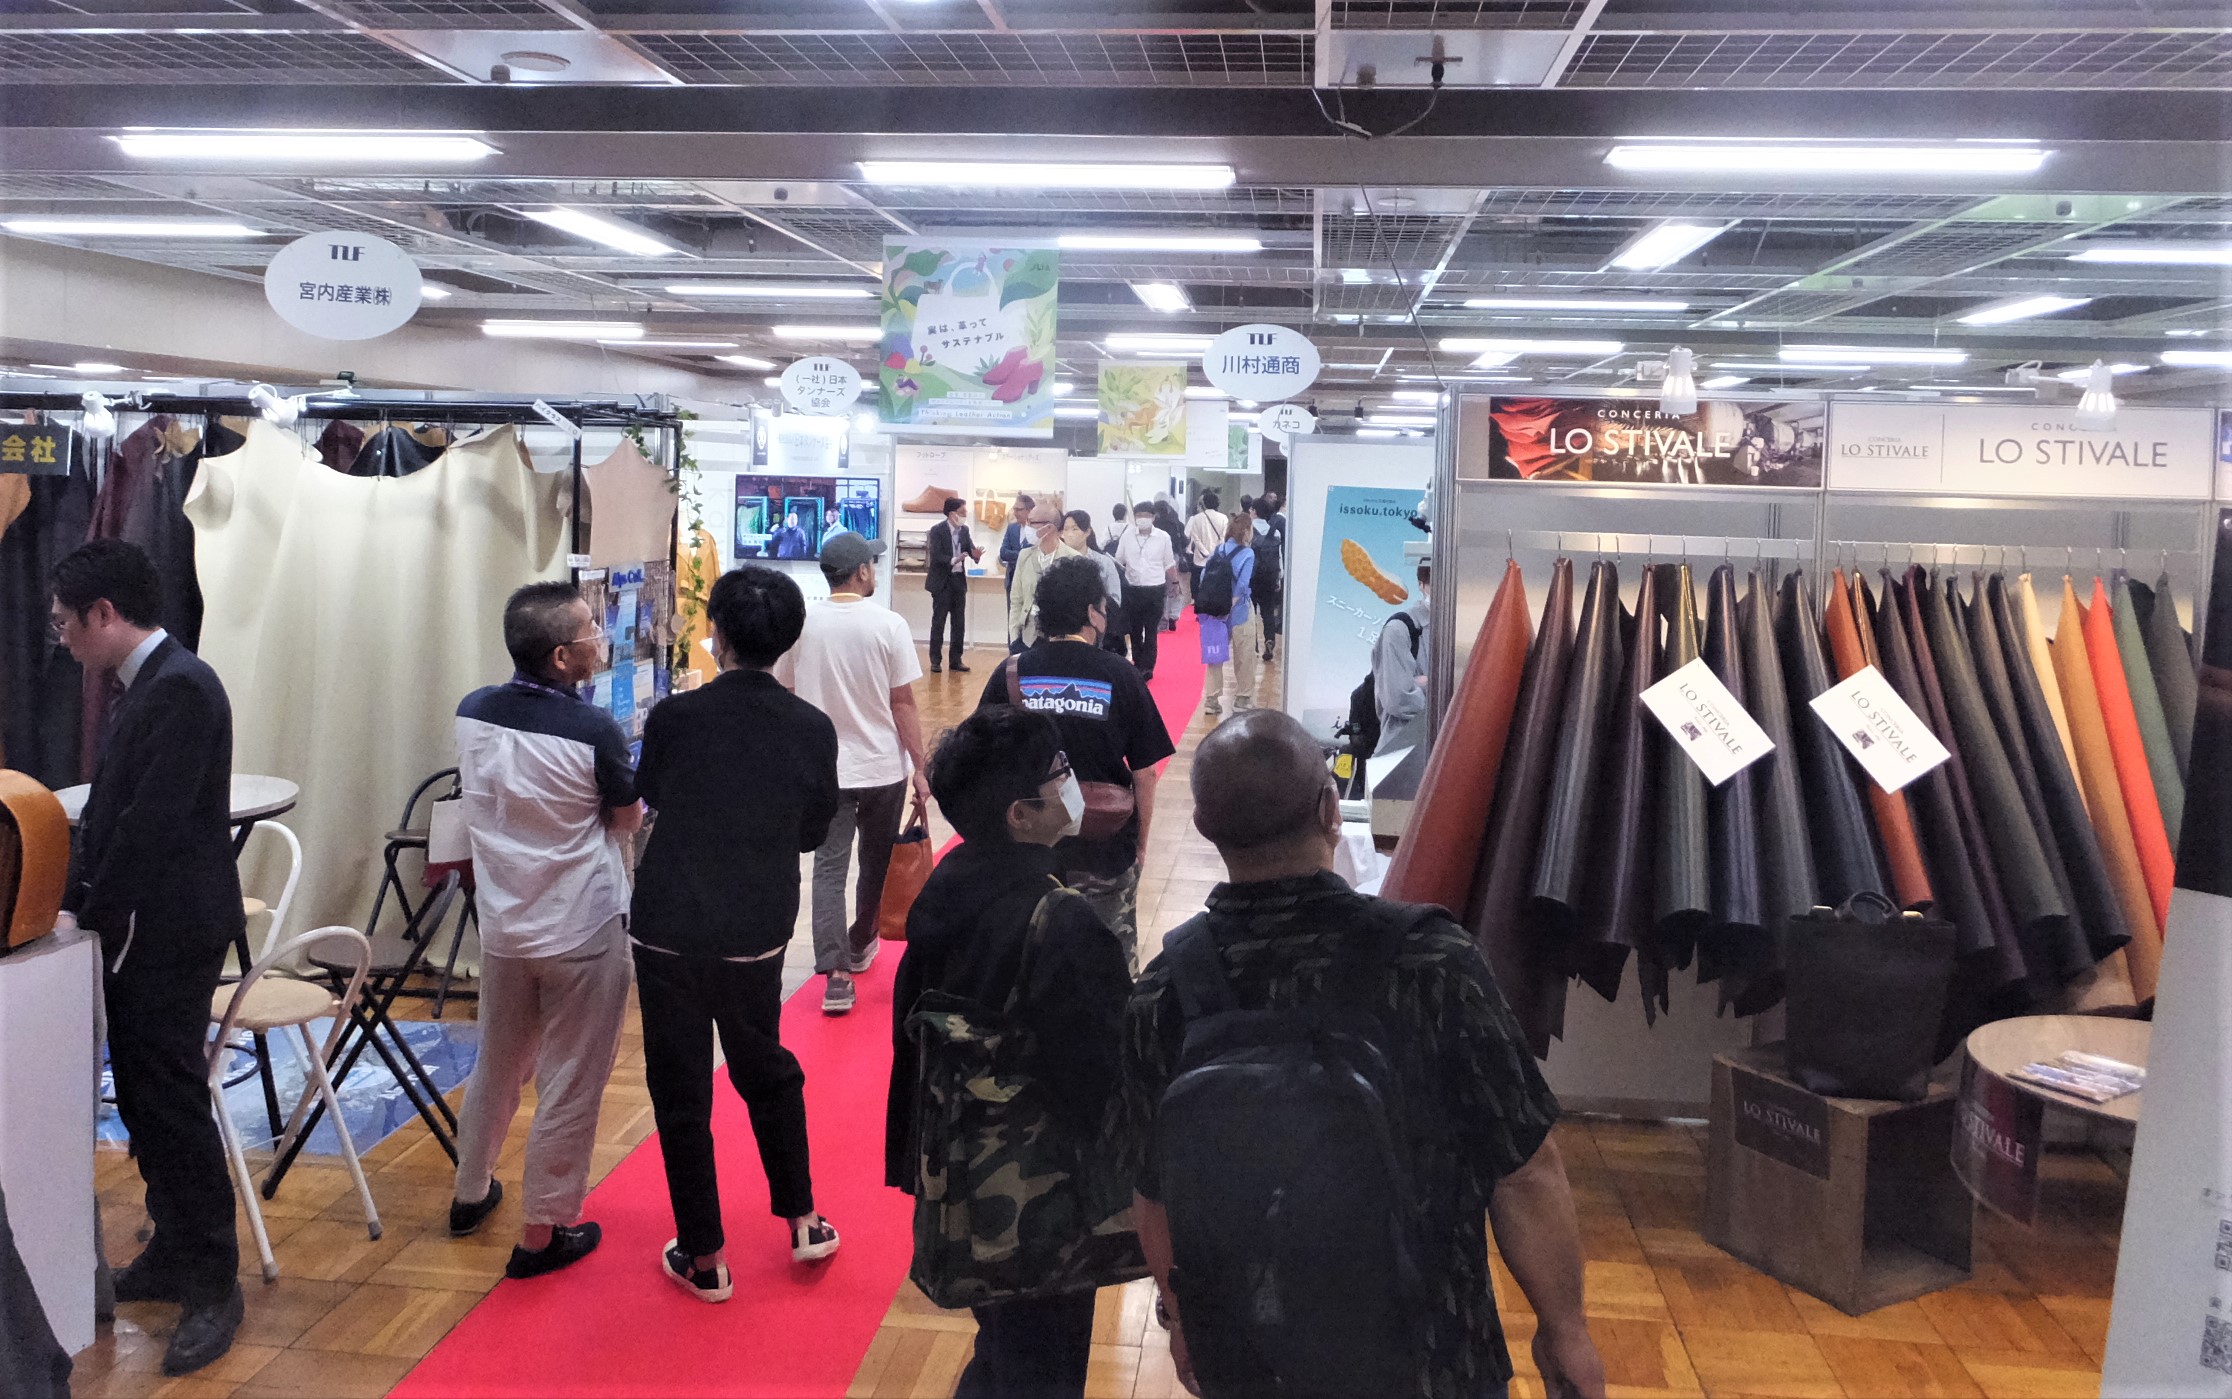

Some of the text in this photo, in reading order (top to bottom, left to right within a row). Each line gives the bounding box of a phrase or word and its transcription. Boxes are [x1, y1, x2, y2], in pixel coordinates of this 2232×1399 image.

[941, 332, 1005, 349] サステナブル
[1222, 355, 1301, 375] 川村通商
[797, 386, 847, 397] タンナーズ
[811, 397, 831, 408] 協会
[1272, 420, 1301, 431] カネコ
[1, 434, 57, 463] 会社
[1550, 427, 1732, 459] LO STIVALE
[1841, 443, 1930, 458] LO STIVALE
[1979, 438, 2169, 468] LO STIVALE
[1339, 503, 1418, 520] issoku.tokyo
[1679, 683, 1743, 755] LO STIVALE
[1851, 690, 1918, 763] LO STIVALE
